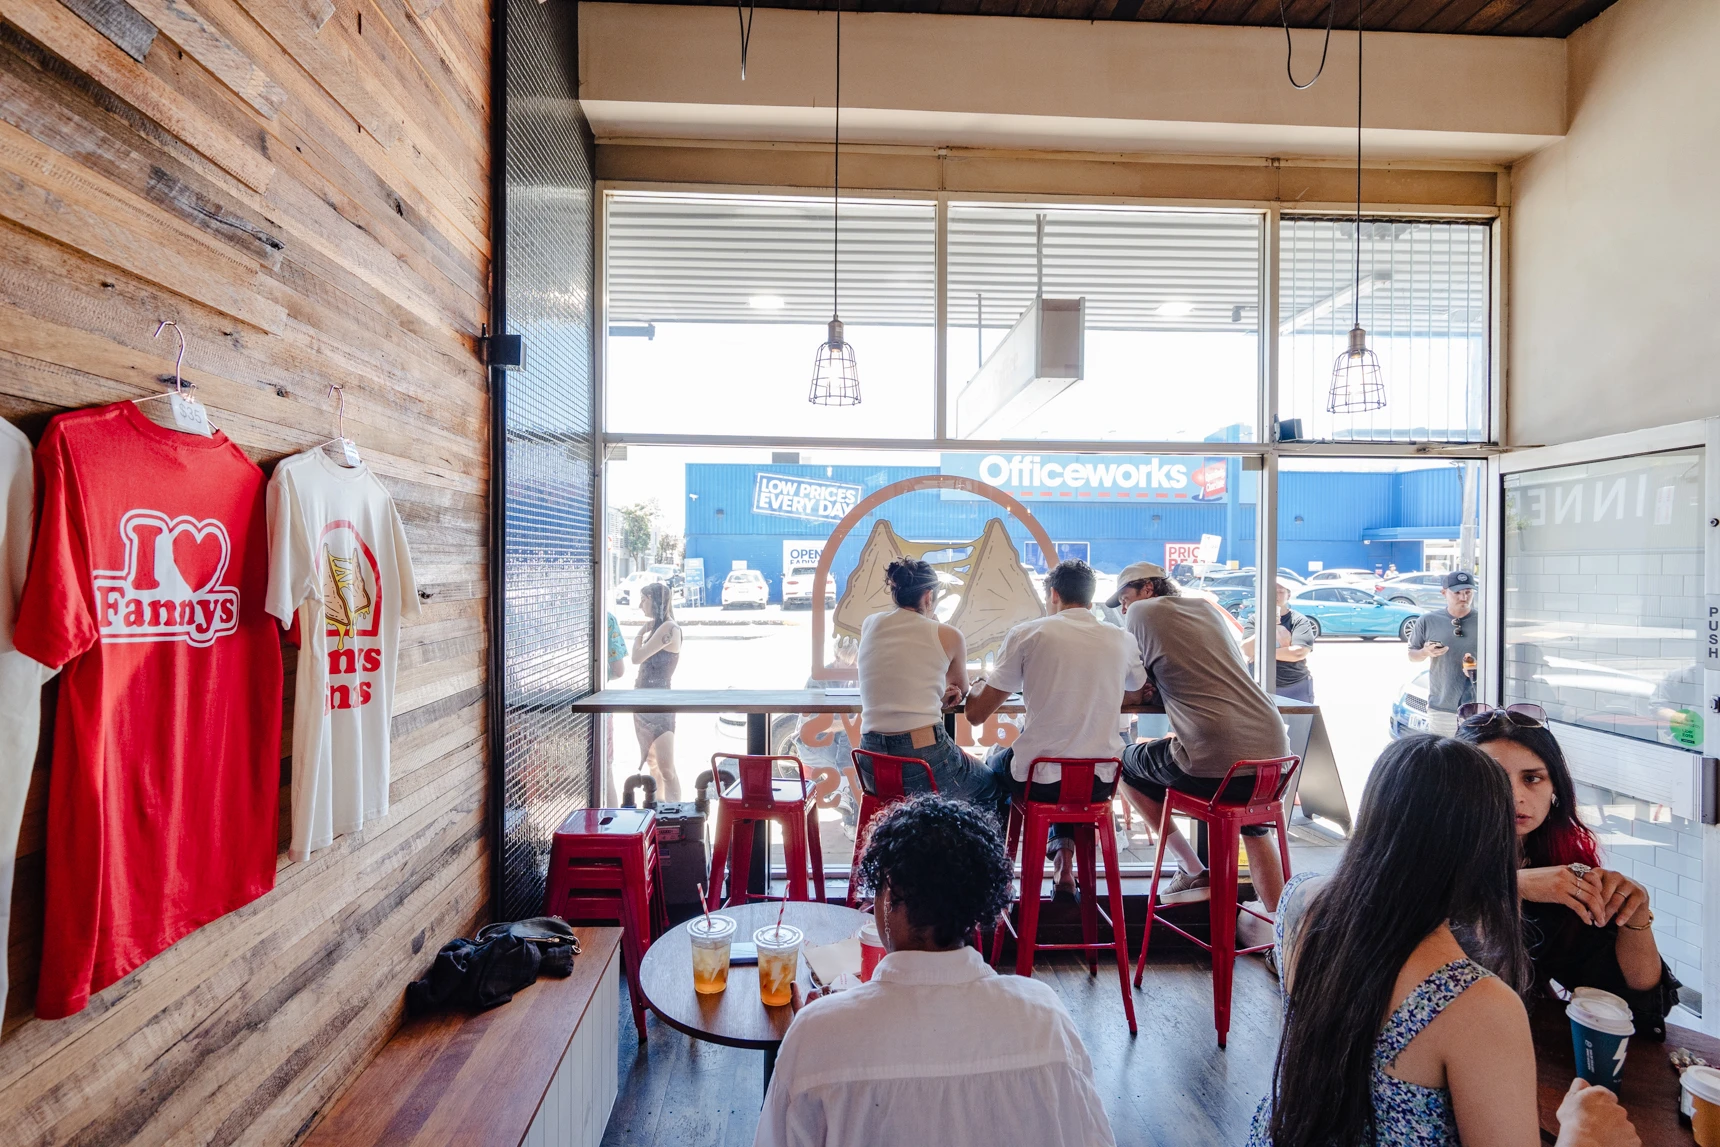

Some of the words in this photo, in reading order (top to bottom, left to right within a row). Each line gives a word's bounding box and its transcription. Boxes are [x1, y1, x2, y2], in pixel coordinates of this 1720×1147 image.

[179, 402, 202, 424] $35
[979, 455, 1188, 489] Officeworks
[759, 491, 816, 514] EVERY
[818, 500, 855, 518] DAY
[761, 478, 798, 496] LOW
[799, 483, 856, 504] PRICES
[131, 523, 163, 591] I
[790, 549, 823, 560] OPEN
[1168, 546, 1200, 558] PRIC
[97, 586, 234, 634] Fannys
[1709, 606, 1719, 659] PUSH
